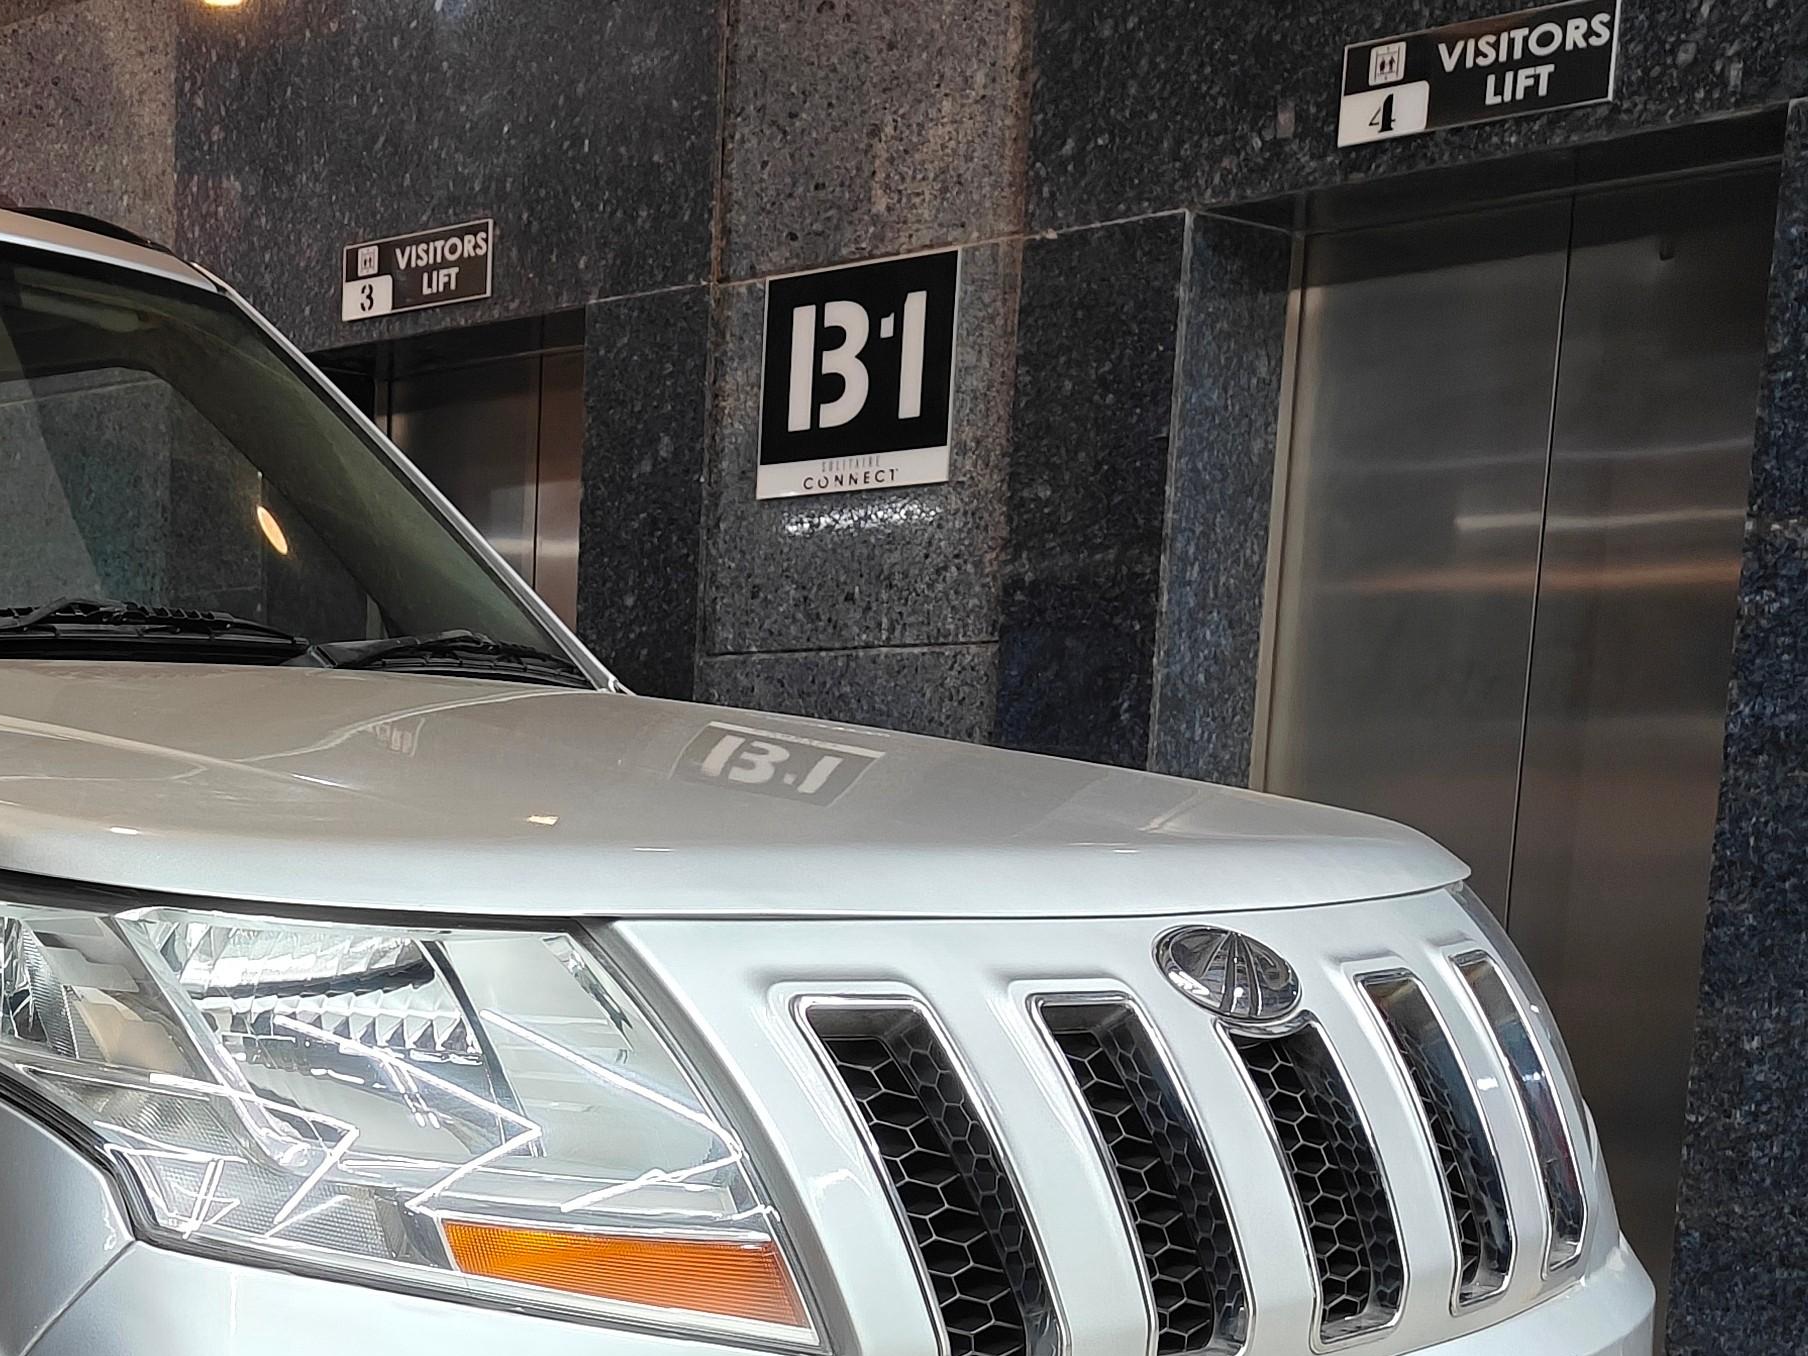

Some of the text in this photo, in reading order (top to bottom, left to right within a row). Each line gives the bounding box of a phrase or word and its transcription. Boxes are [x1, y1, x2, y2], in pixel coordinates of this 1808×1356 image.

[1438, 13, 1611, 72] VISITORS
[1485, 64, 1555, 105] LIFT
[1368, 93, 1396, 133] 4
[395, 231, 488, 270] VISITORS
[360, 283, 374, 312] 3
[422, 267, 460, 295] LIFT
[803, 469, 895, 490] CONNECT
